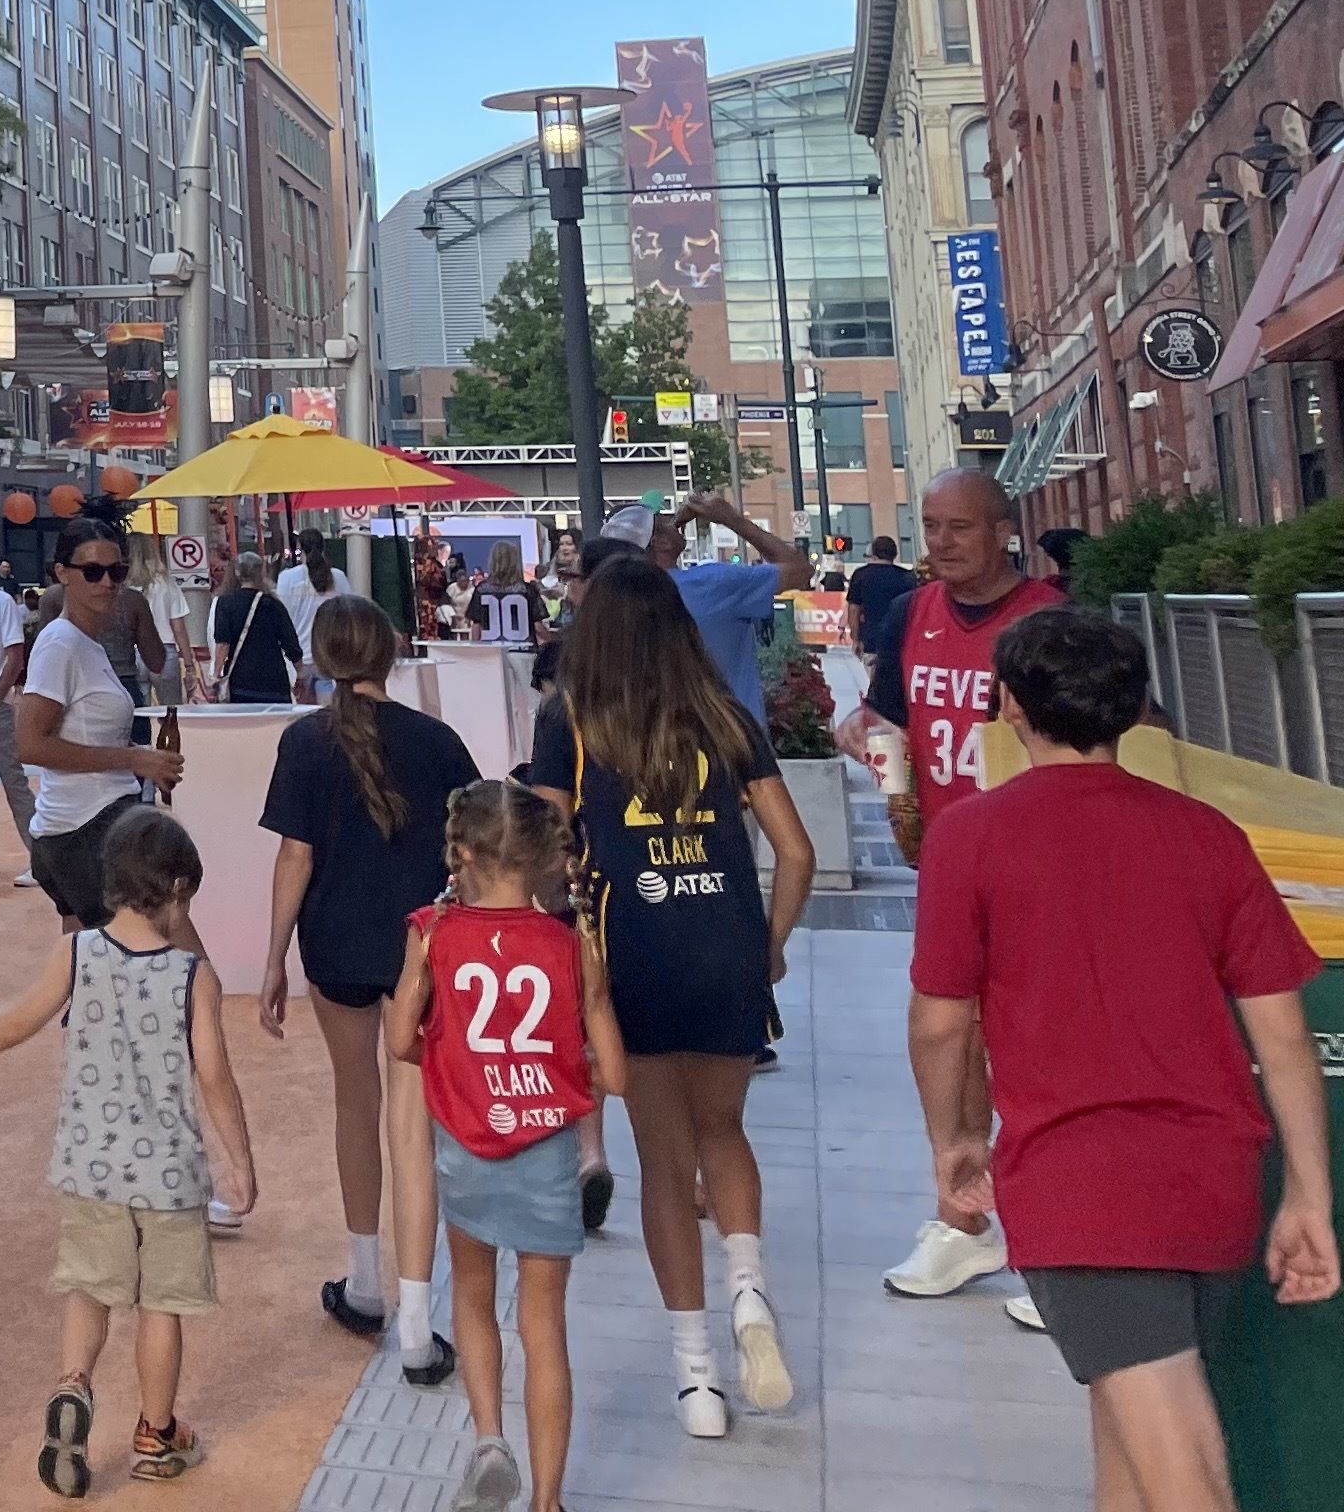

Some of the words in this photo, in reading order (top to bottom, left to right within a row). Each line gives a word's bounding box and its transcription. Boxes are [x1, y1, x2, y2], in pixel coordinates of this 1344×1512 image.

[665, 173, 688, 182] AT&T
[632, 194, 664, 204] ALL
[911, 664, 993, 710] FEVE
[929, 718, 988, 792] 34
[648, 835, 709, 865] CLARK
[673, 873, 725, 896] AT&T
[454, 962, 554, 1054] 22
[483, 1063, 554, 1097] CLARK
[521, 1107, 568, 1128] AT&T
